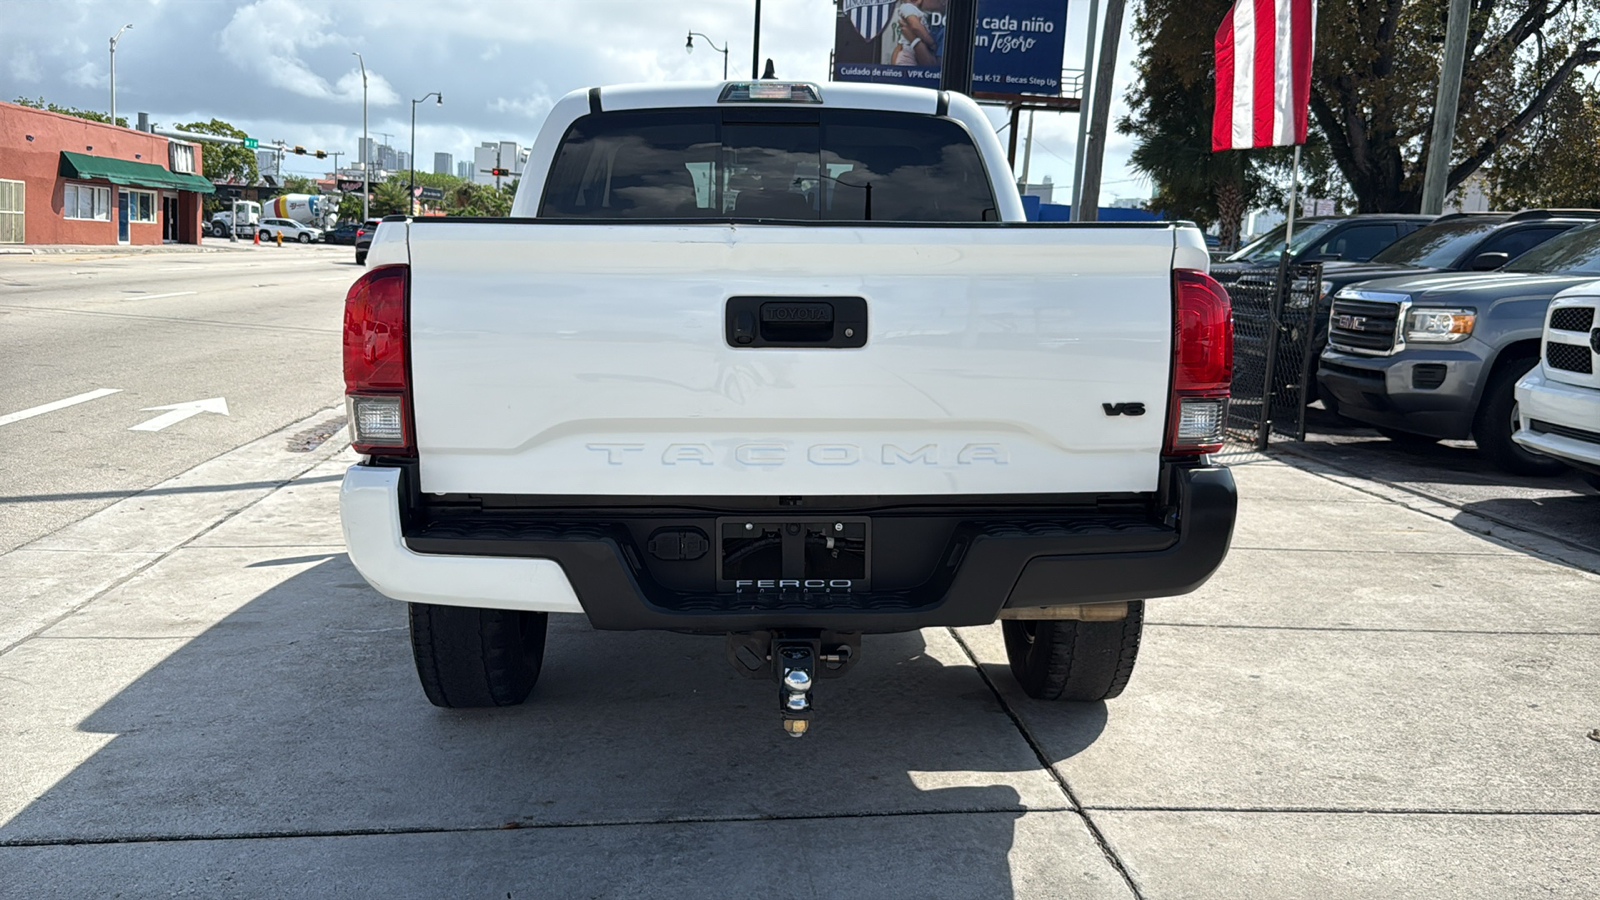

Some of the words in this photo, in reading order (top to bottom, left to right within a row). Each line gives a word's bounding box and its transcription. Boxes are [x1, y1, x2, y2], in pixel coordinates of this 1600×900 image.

[982, 14, 1018, 31] cada
[1021, 17, 1054, 33] niño
[990, 31, 1037, 54] Tesoro
[840, 67, 871, 76] Cuidado
[882, 69, 903, 78] niños
[907, 70, 923, 78] VPK
[924, 71, 941, 79] Grat
[984, 74, 1001, 83] K-12
[1006, 75, 1028, 84] Becas
[1029, 77, 1045, 87] Step
[1046, 78, 1058, 88] Up
[767, 308, 828, 319] TOYOTA
[1339, 314, 1367, 331] GMC
[1102, 402, 1146, 416] V6
[585, 443, 1011, 465] TACOMA
[736, 580, 852, 588] FERCO
